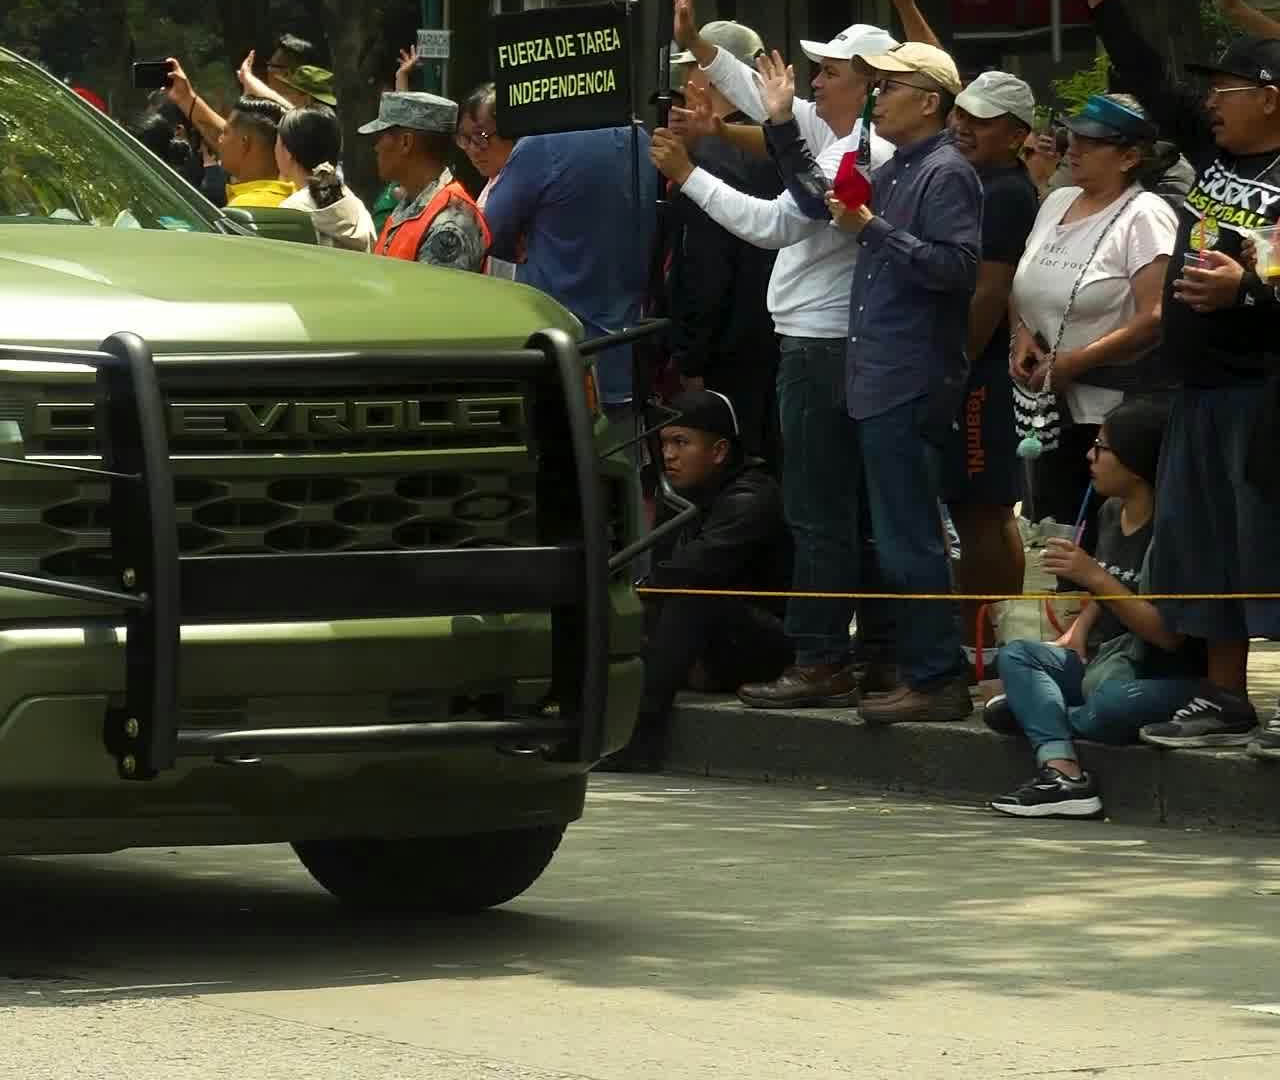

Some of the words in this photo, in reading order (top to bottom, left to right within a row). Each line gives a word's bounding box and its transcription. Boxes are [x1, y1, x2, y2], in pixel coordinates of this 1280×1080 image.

[498, 37, 555, 69] FUERZA
[555, 34, 576, 58] DE
[577, 27, 621, 55] TAREA
[509, 69, 616, 107] INDEPENDENCIA
[32, 395, 526, 439] CEVROLE
